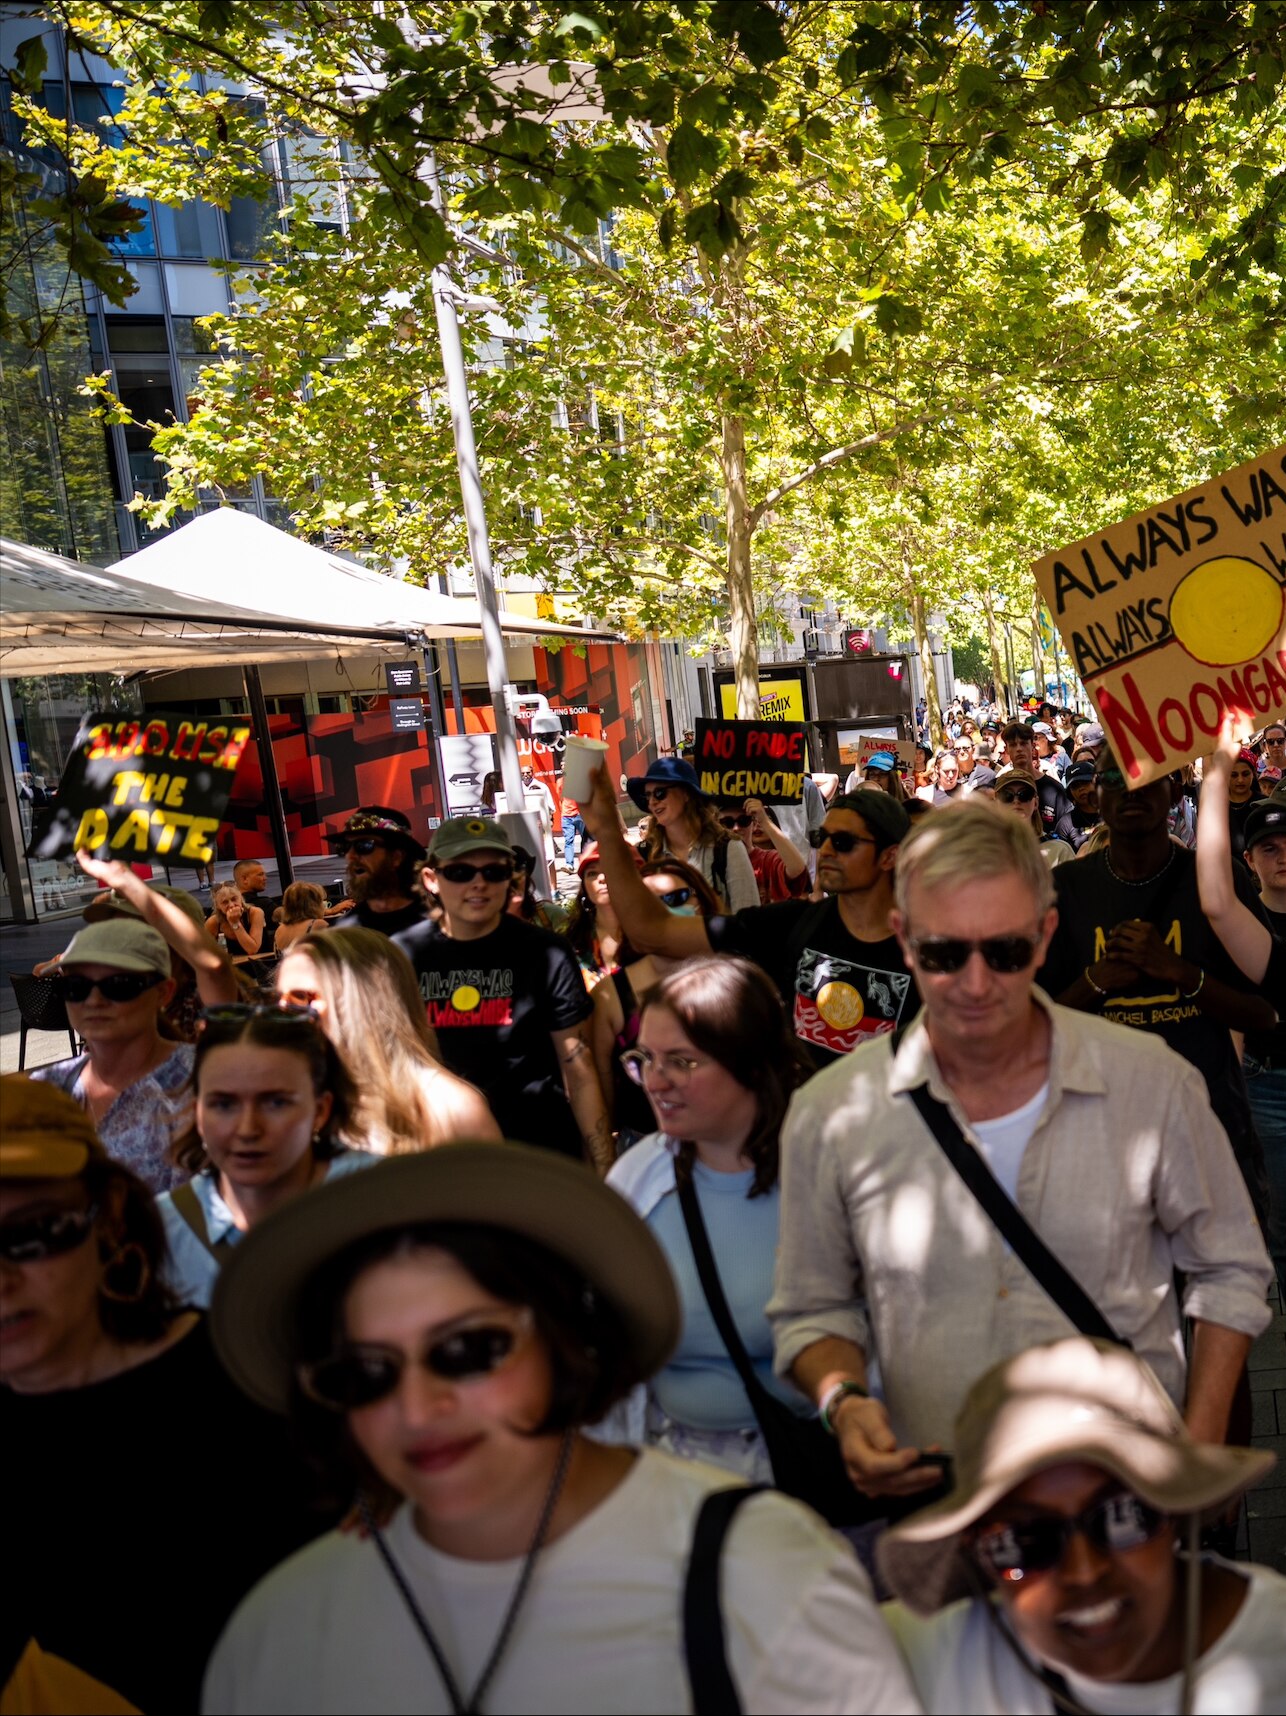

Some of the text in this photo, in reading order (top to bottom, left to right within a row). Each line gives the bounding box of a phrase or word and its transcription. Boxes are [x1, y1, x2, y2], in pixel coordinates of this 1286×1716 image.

[1053, 497, 1218, 615] ALWAYS
[1072, 598, 1174, 676] ALWAYS
[703, 729, 803, 760] NO PRIDE
[864, 741, 897, 752] ALWAYS
[112, 770, 188, 807] THE
[700, 770, 804, 799] IN GENOCIDE
[73, 808, 220, 863] DATE
[1151, 1005, 1202, 1023] BASQUIA
